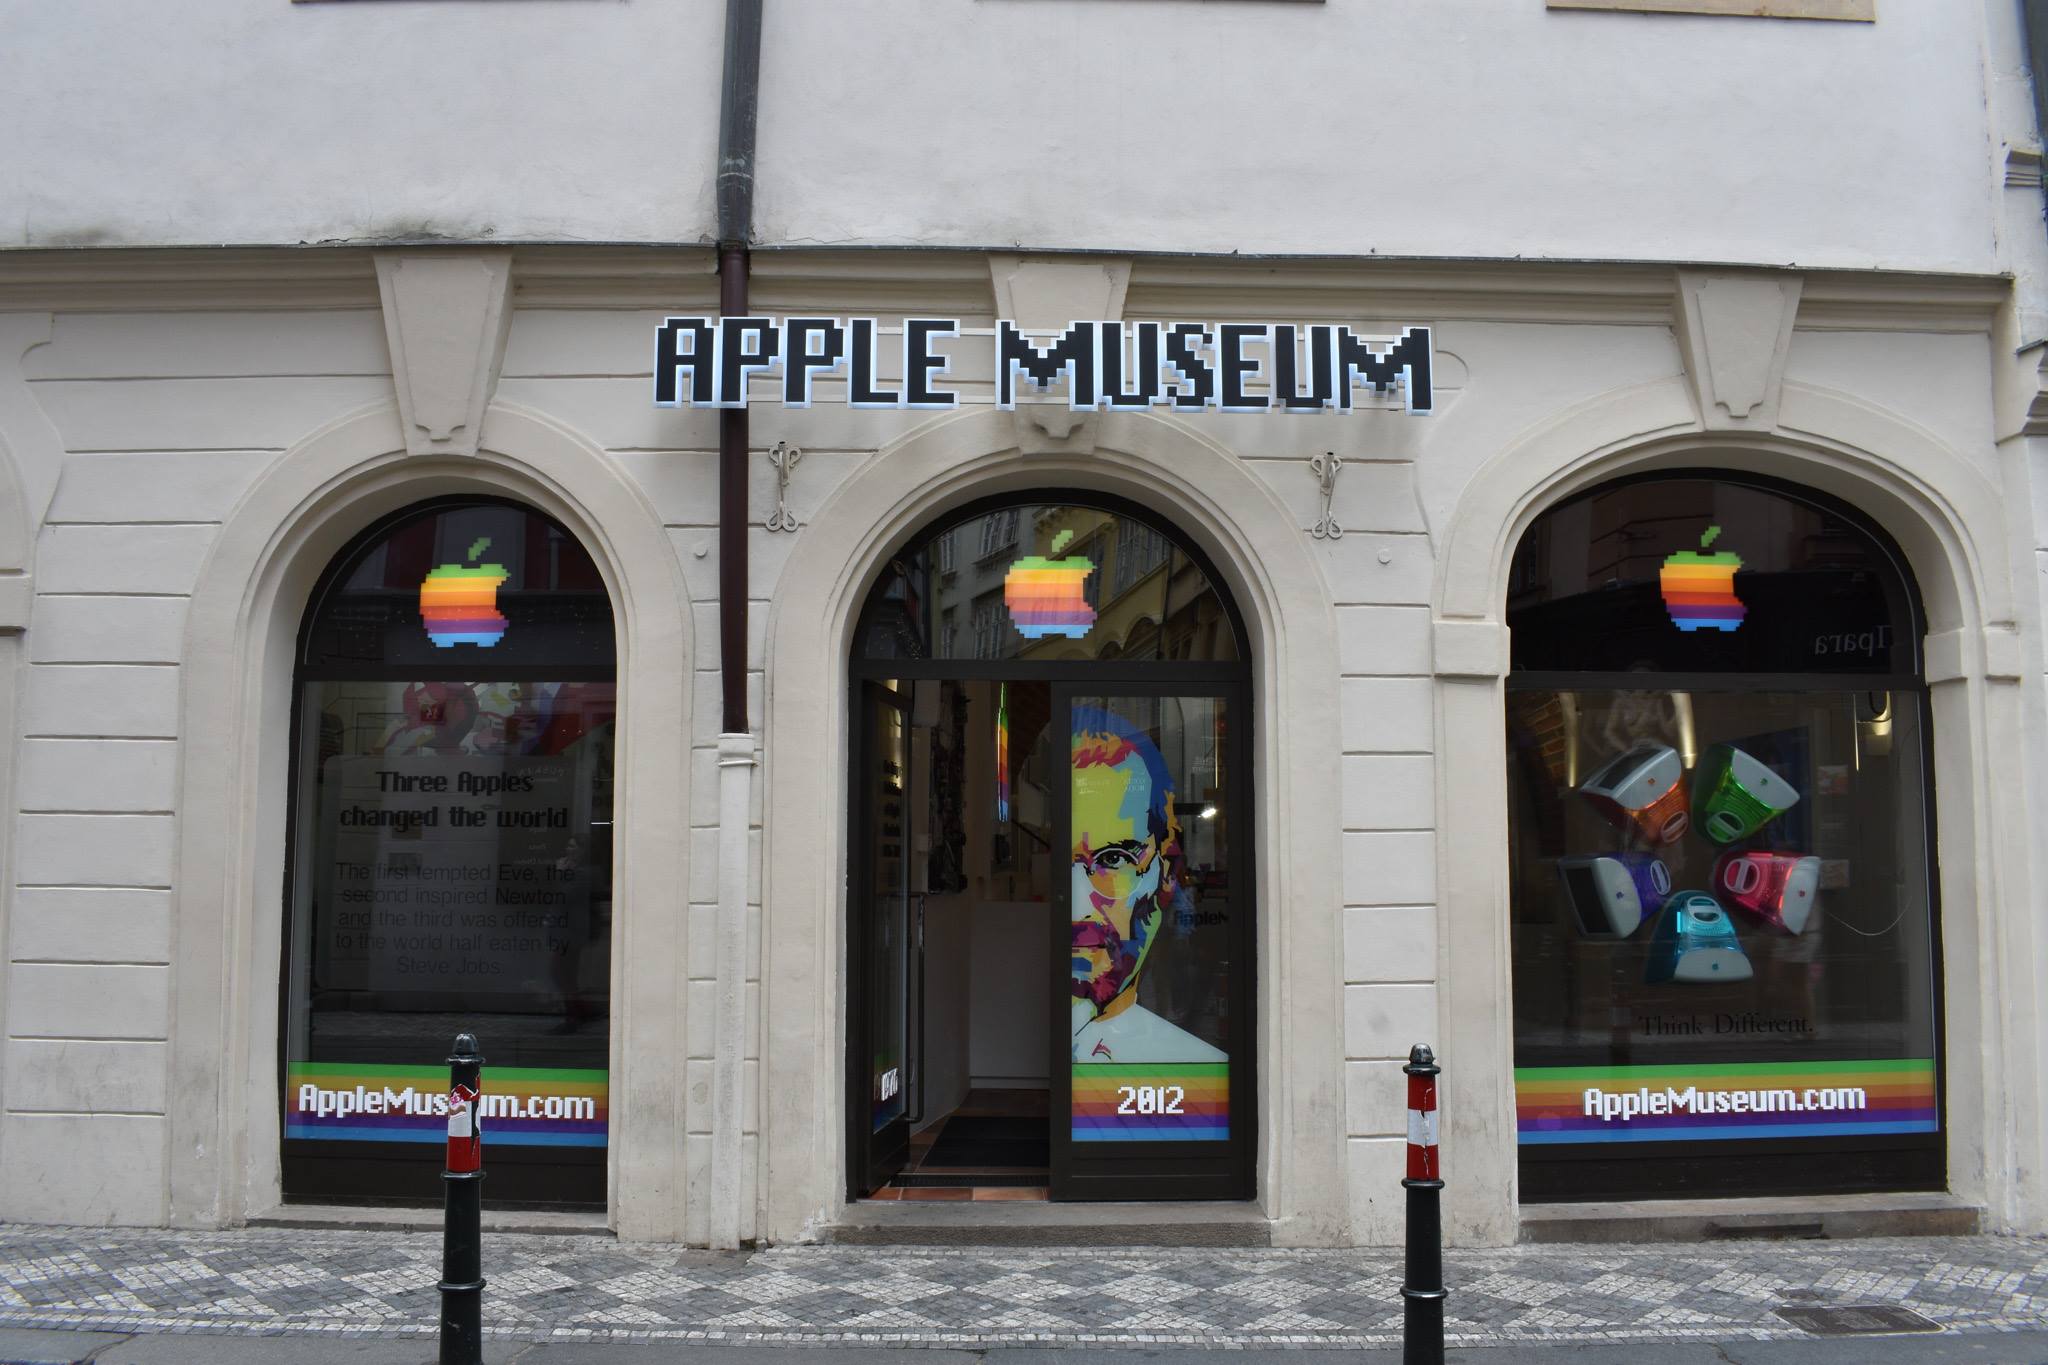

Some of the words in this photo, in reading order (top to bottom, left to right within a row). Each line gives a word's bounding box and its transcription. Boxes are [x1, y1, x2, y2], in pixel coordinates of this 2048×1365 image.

[654, 317, 960, 408] APPLE
[996, 319, 1435, 415] MUSEUM
[375, 771, 448, 792] Three
[457, 771, 534, 796] Apples
[340, 806, 438, 832] changed
[449, 806, 487, 828] the
[496, 807, 568, 828] world
[335, 862, 370, 880] The
[376, 863, 410, 880] first
[416, 863, 491, 882] tempted
[546, 864, 576, 881] the
[343, 887, 408, 903] second
[415, 888, 488, 907] inspired
[495, 888, 567, 905] Newton
[338, 911, 372, 927] and
[378, 912, 407, 927] the
[414, 912, 453, 928] third
[460, 914, 497, 928] was
[503, 912, 568, 929] offered
[335, 934, 352, 950] to
[359, 934, 387, 950] the
[394, 935, 441, 951] world
[449, 935, 482, 951] half
[490, 936, 541, 952] eaten
[547, 936, 570, 956] by
[397, 957, 450, 975] Steve
[1639, 1014, 1703, 1035] Think
[1714, 1013, 1814, 1034] Different.
[299, 1084, 595, 1119] AppleMusm.com
[1117, 1086, 1185, 1115] 2012
[1584, 1086, 1866, 1121] AppleMuseum.com
